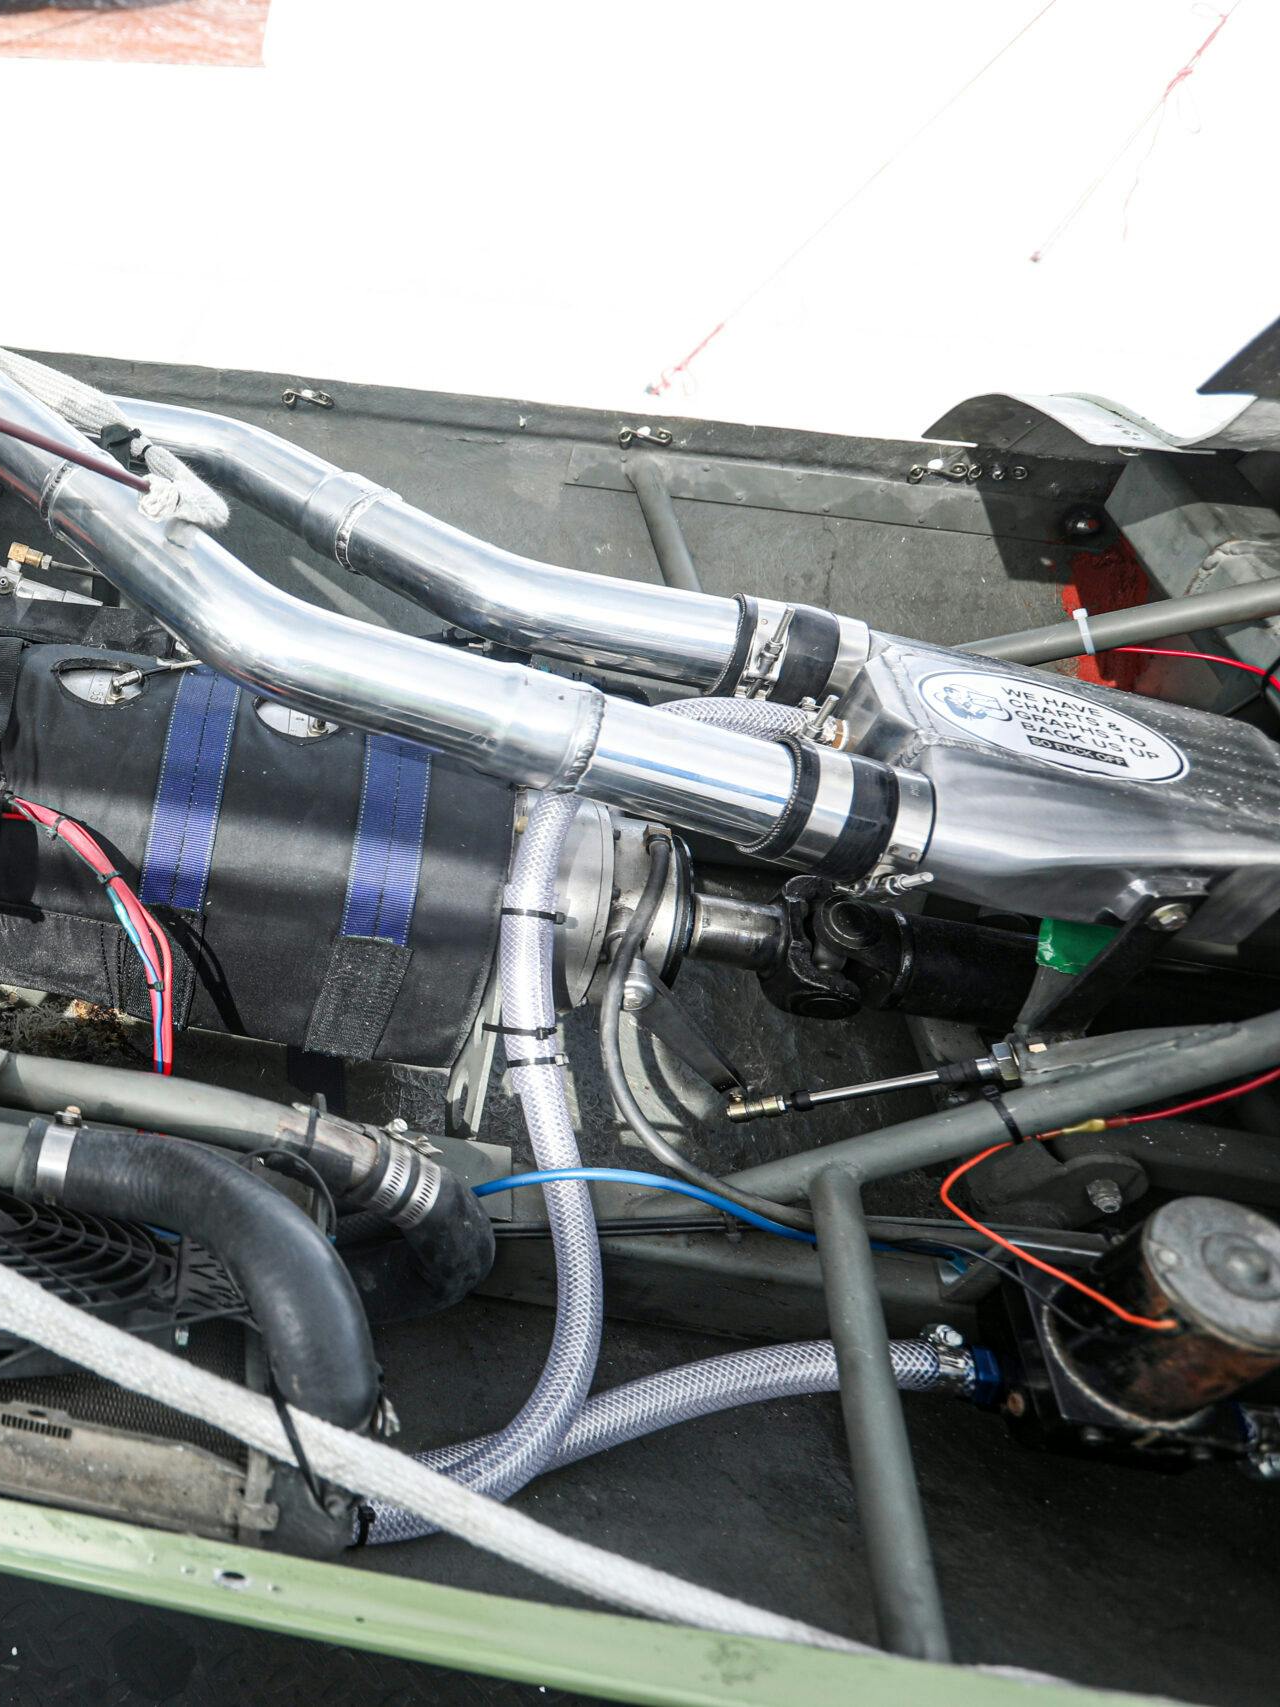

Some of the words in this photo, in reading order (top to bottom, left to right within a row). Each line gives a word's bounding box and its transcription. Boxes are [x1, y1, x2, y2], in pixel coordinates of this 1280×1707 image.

[1001, 686, 1035, 701] WE
[1044, 697, 1104, 718] HAVE
[1009, 699, 1100, 727] CHARTS
[1107, 722, 1124, 733] &
[1015, 711, 1110, 739] GRAPHS
[1119, 734, 1146, 748] TO
[1021, 721, 1087, 744] BACK
[1092, 739, 1124, 752] US
[1130, 747, 1160, 760] UP
[1032, 737, 1053, 748] SO
[1055, 742, 1096, 759] FUCK
[1097, 753, 1125, 765] OFF
